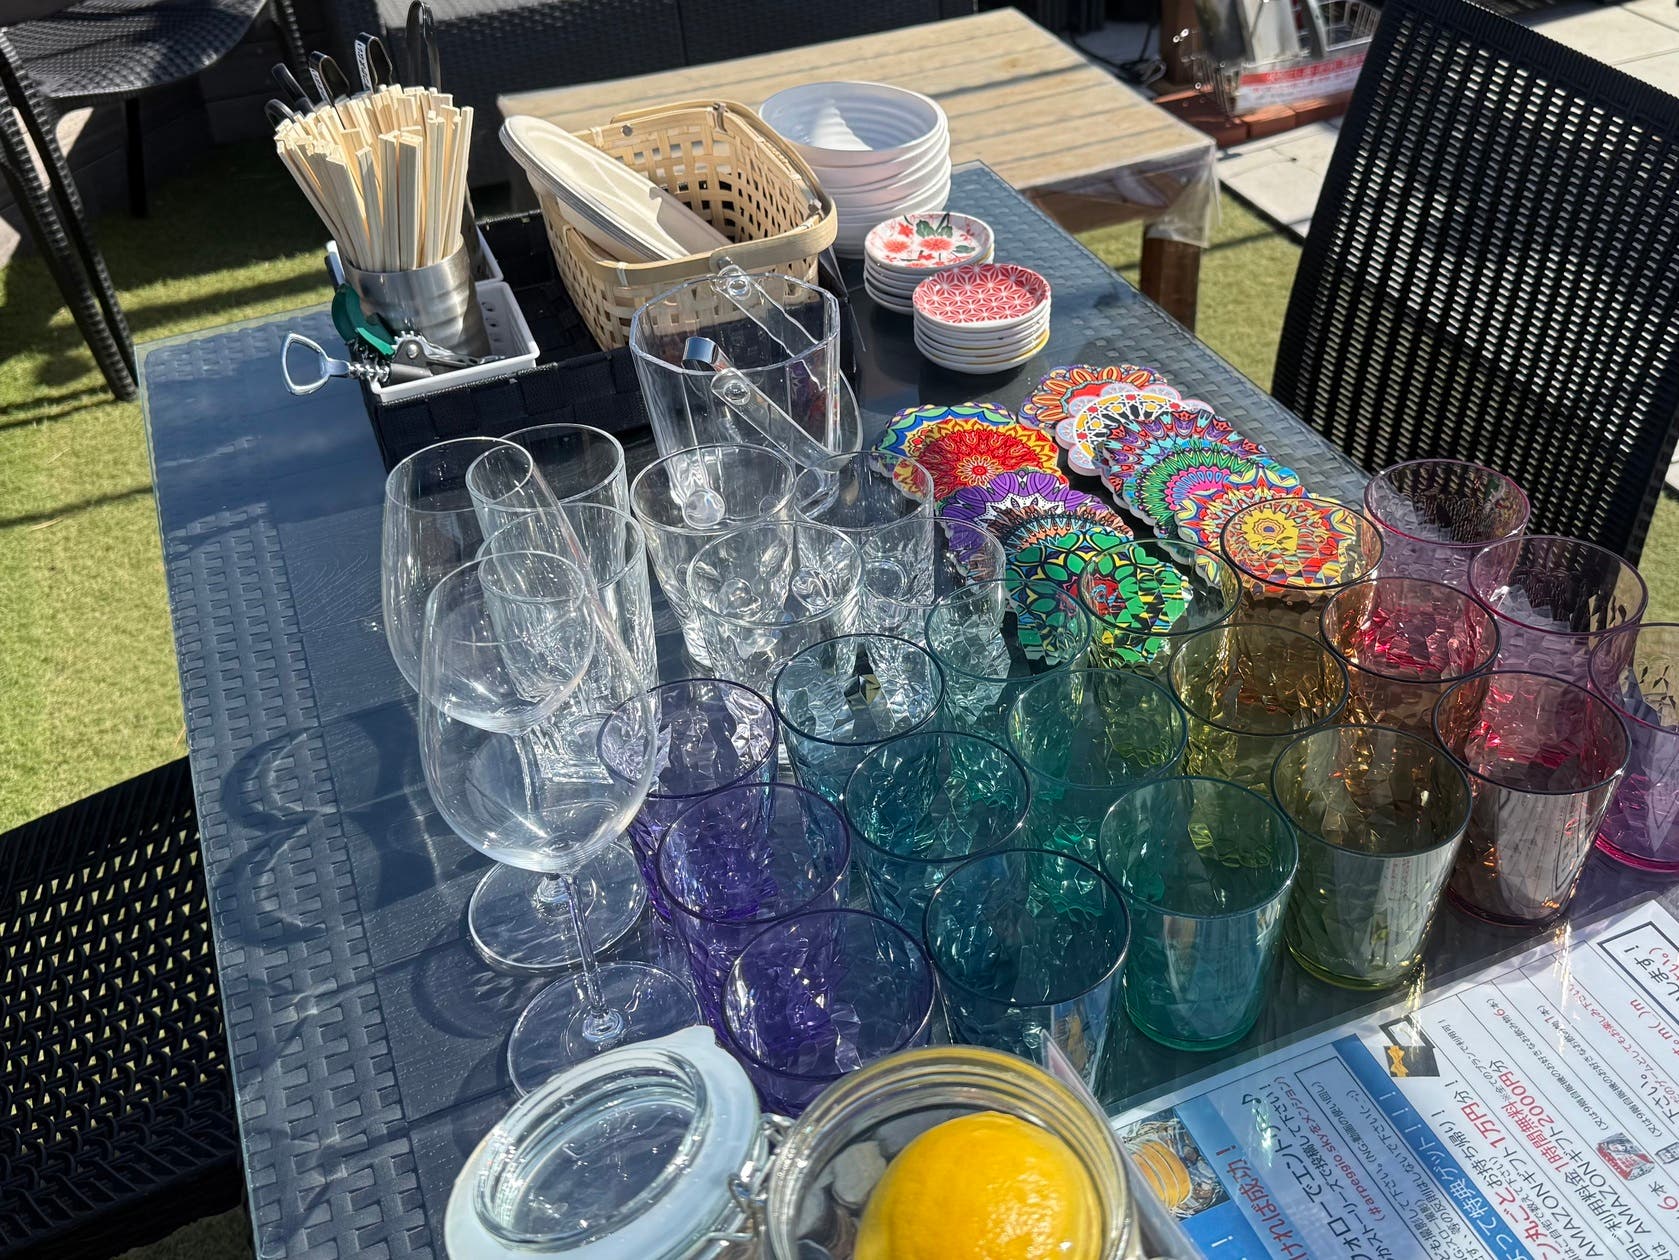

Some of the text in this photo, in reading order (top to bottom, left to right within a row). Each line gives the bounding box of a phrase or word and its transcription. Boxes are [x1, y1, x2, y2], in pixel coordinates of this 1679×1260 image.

[1623, 944, 1679, 1001] します！
[1213, 1143, 1308, 1260] ければ成功！
[1258, 1083, 1394, 1260] かストーリーズで投稿して下さい！
[1428, 1108, 1565, 1260] ン丸ごとお持ち帰り！
[1487, 1156, 1580, 1258] はご自宅で数えて下さい)
[1414, 1198, 1468, 1259] G:スロー撮影)
